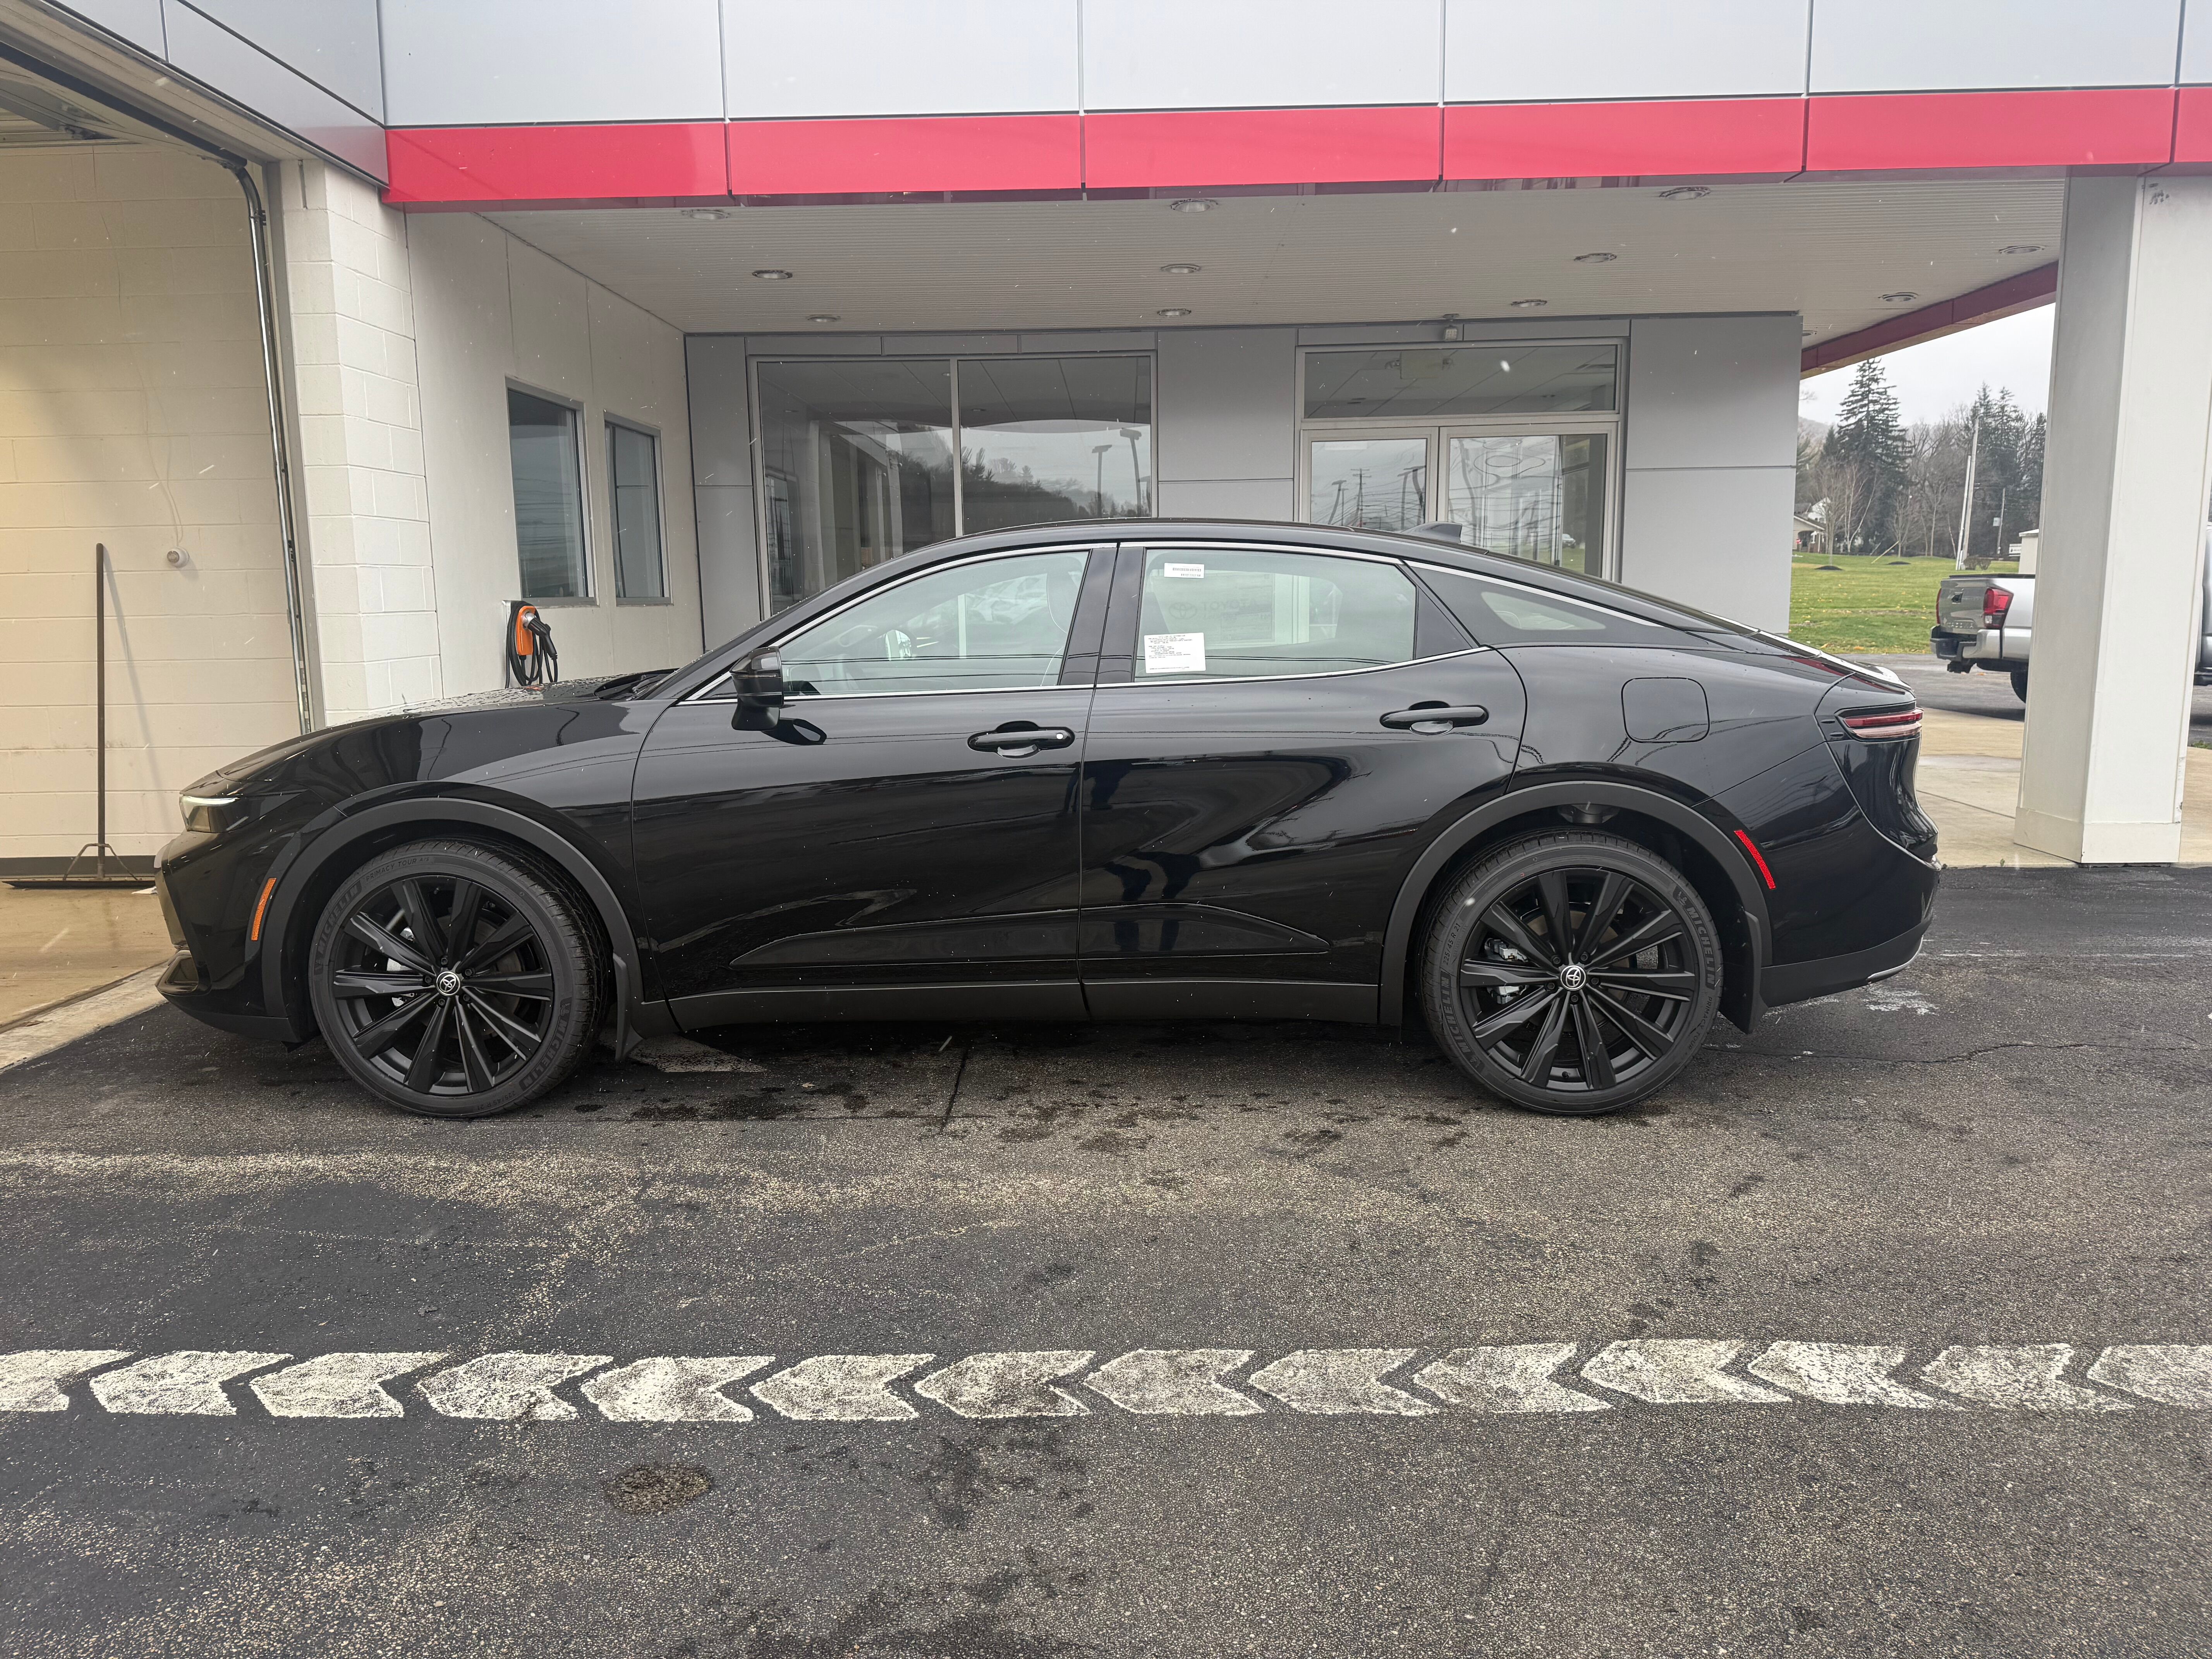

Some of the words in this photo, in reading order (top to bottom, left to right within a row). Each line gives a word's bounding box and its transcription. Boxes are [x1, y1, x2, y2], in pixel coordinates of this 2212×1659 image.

[1200, 598, 1256, 611] TOYOTA
[366, 864, 395, 881] PRIMACY
[398, 858, 417, 867] TOUR
[318, 884, 358, 954] MICHELIN
[1443, 938, 1454, 966] 225/45
[1451, 930, 1456, 938] R
[1454, 922, 1462, 932] 21
[1686, 907, 1715, 985] MICHELIN
[1440, 976, 1471, 1053] MICHELIN
[1700, 996, 1713, 1029] PRIMACY
[524, 1018, 567, 1088] MICHELIN
[1688, 1031, 1700, 1050] TOUR
[494, 1090, 515, 1107] 225/45
